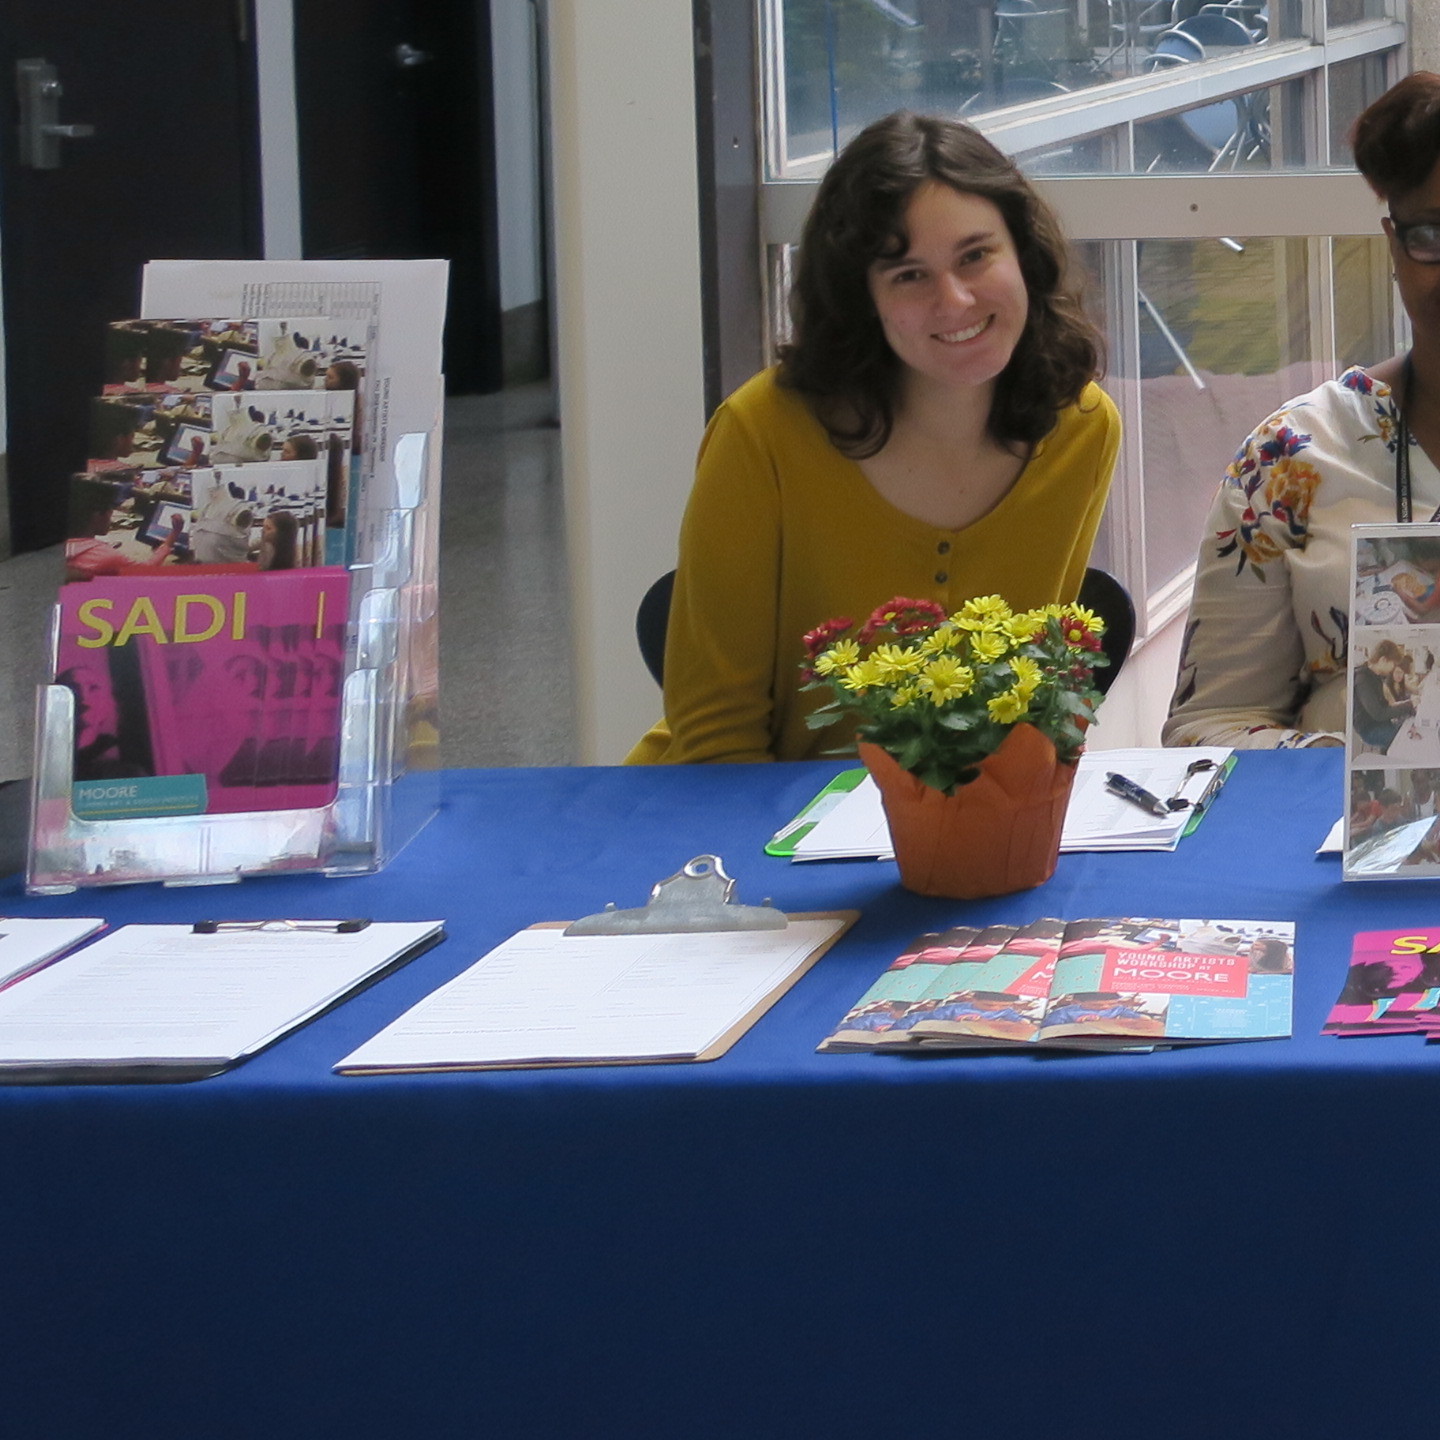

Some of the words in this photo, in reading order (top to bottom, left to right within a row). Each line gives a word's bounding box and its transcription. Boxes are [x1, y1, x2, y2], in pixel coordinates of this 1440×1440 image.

[76, 591, 247, 649] SADI
[79, 785, 139, 800] MOORE
[1116, 959, 1196, 969] WORKSHOP
[1118, 952, 1166, 961] YOUNG
[1173, 956, 1235, 965] ARTISTS
[1113, 968, 1229, 982] MOORE
